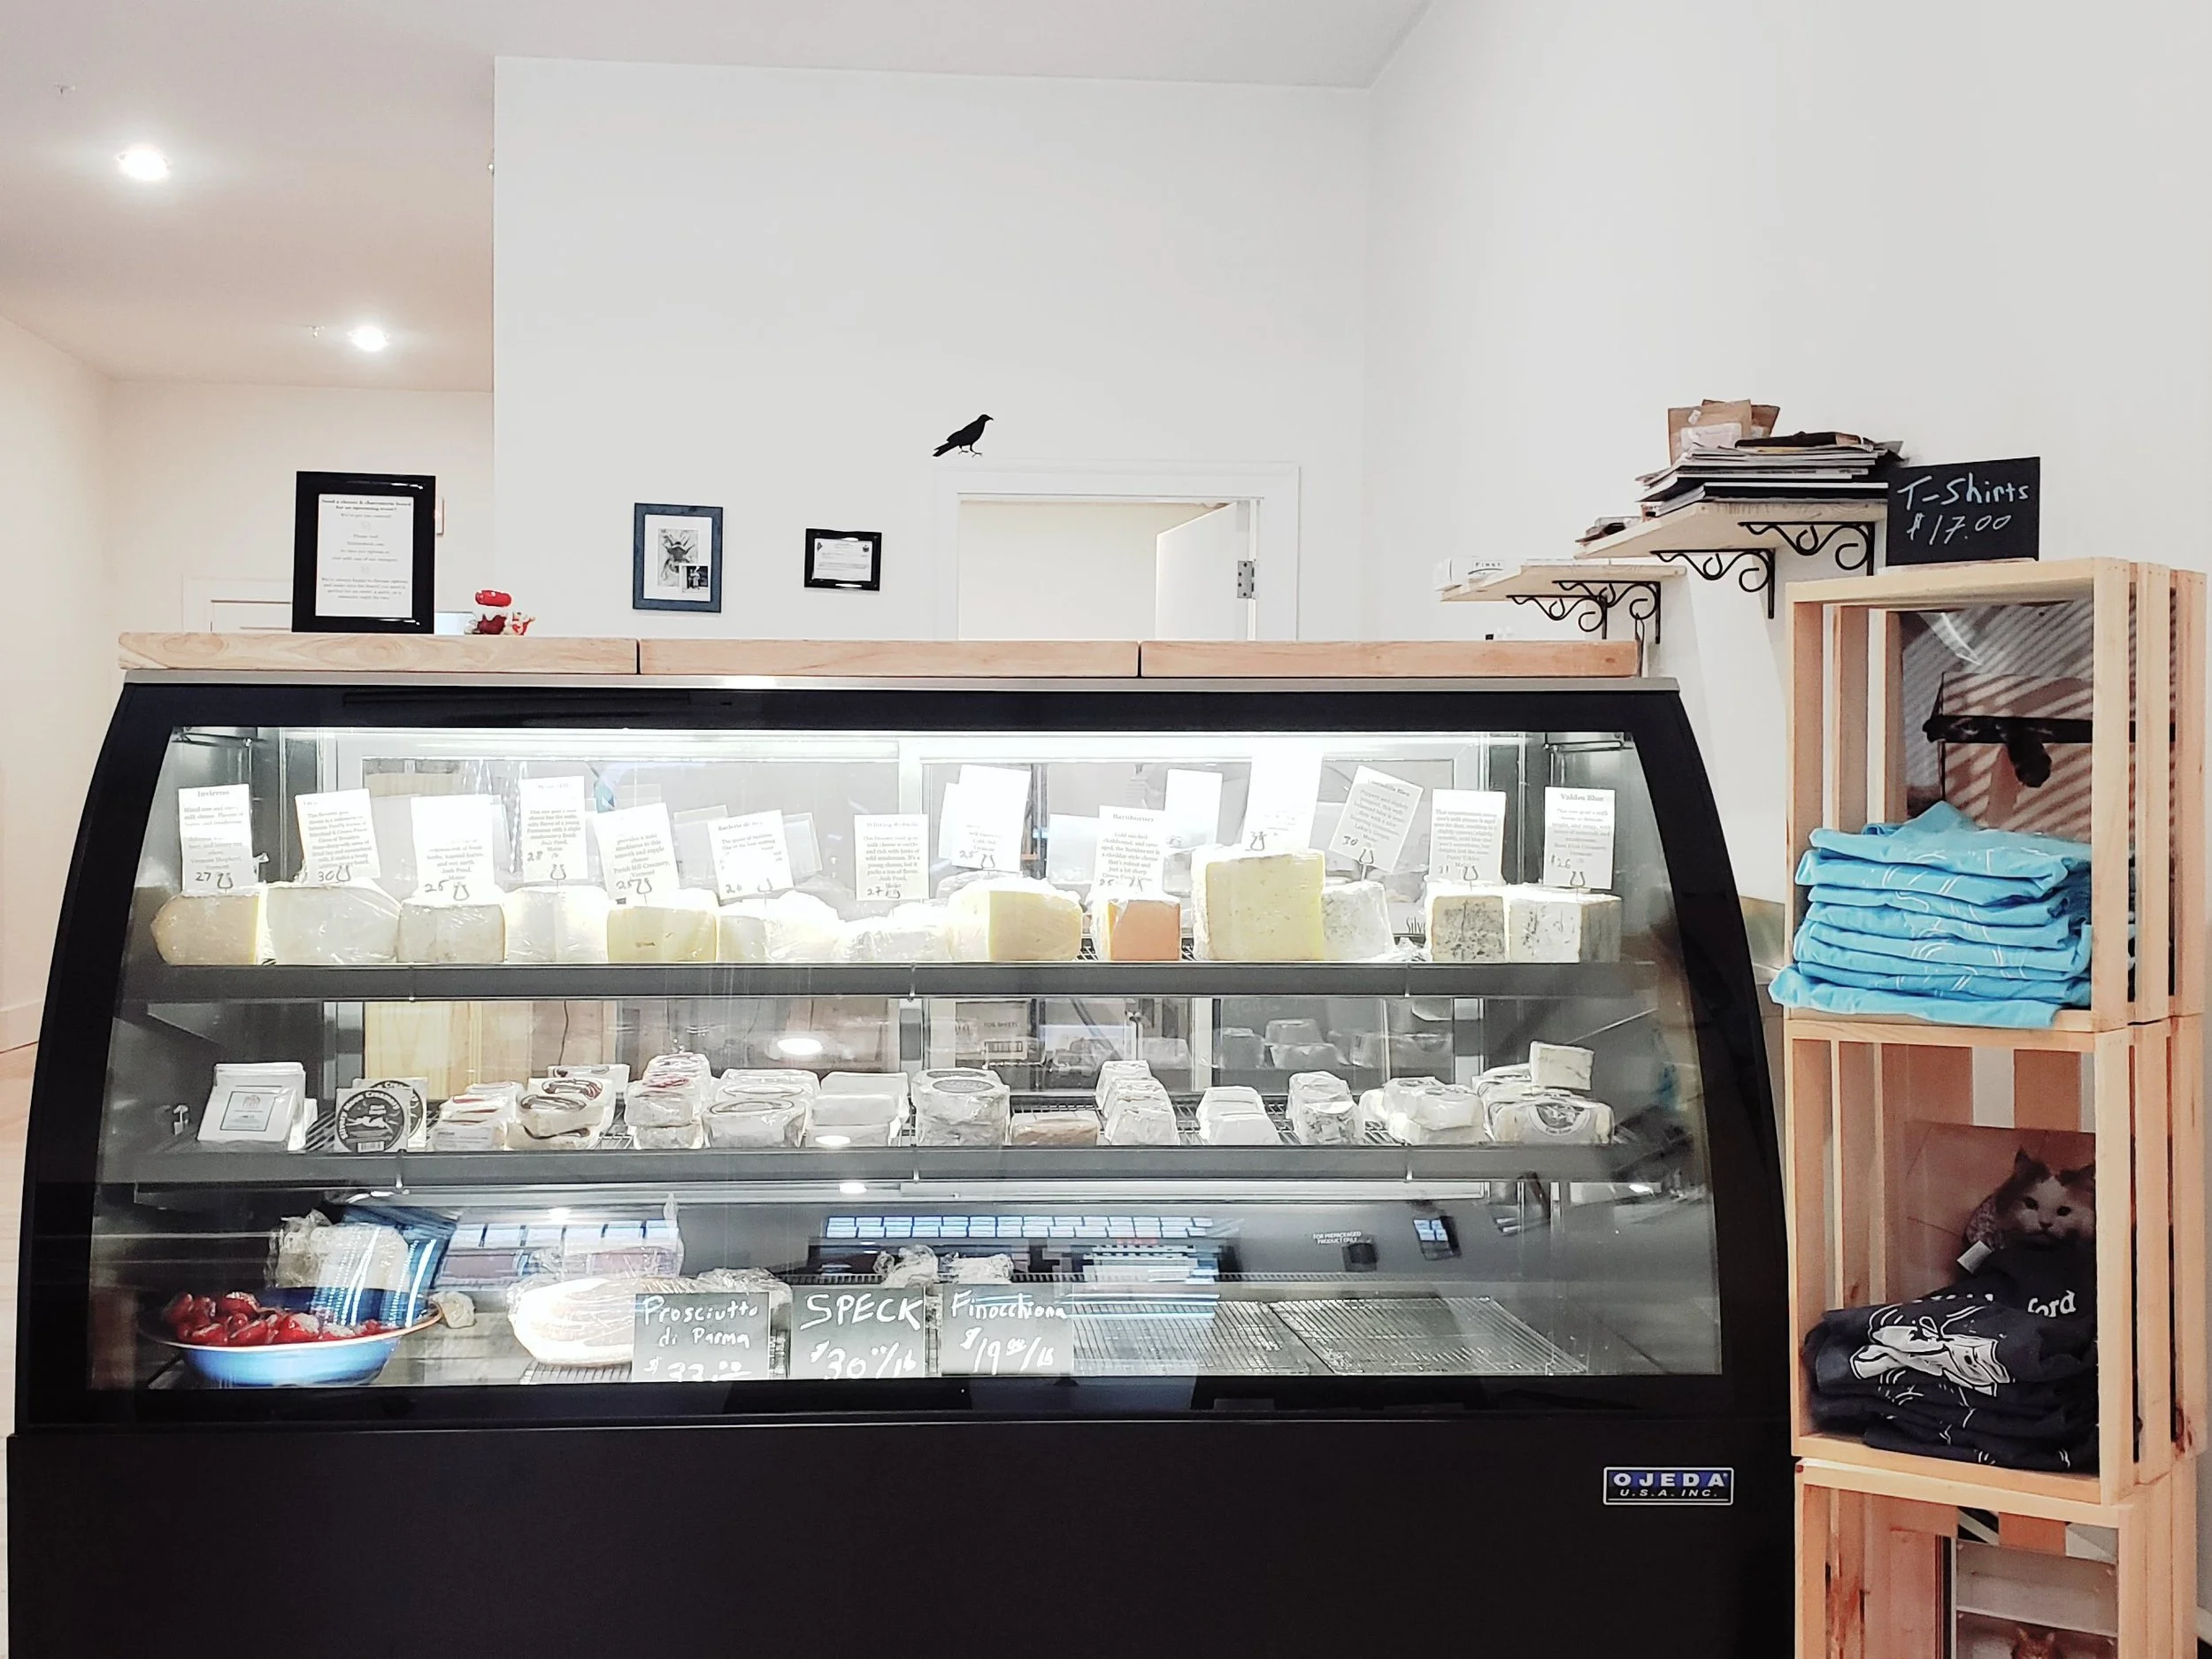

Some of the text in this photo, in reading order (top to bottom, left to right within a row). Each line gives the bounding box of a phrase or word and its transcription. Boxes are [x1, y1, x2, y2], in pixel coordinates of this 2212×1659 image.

[1897, 472, 2029, 510] T-Shirts
[1907, 513, 2011, 545] $17.00
[643, 1295, 759, 1325] Prosciutto
[800, 1293, 924, 1331] SPECK
[951, 1290, 1067, 1319] Finocchiona
[658, 1327, 750, 1349] di Parma
[1613, 1472, 1724, 1487] OJEDA
